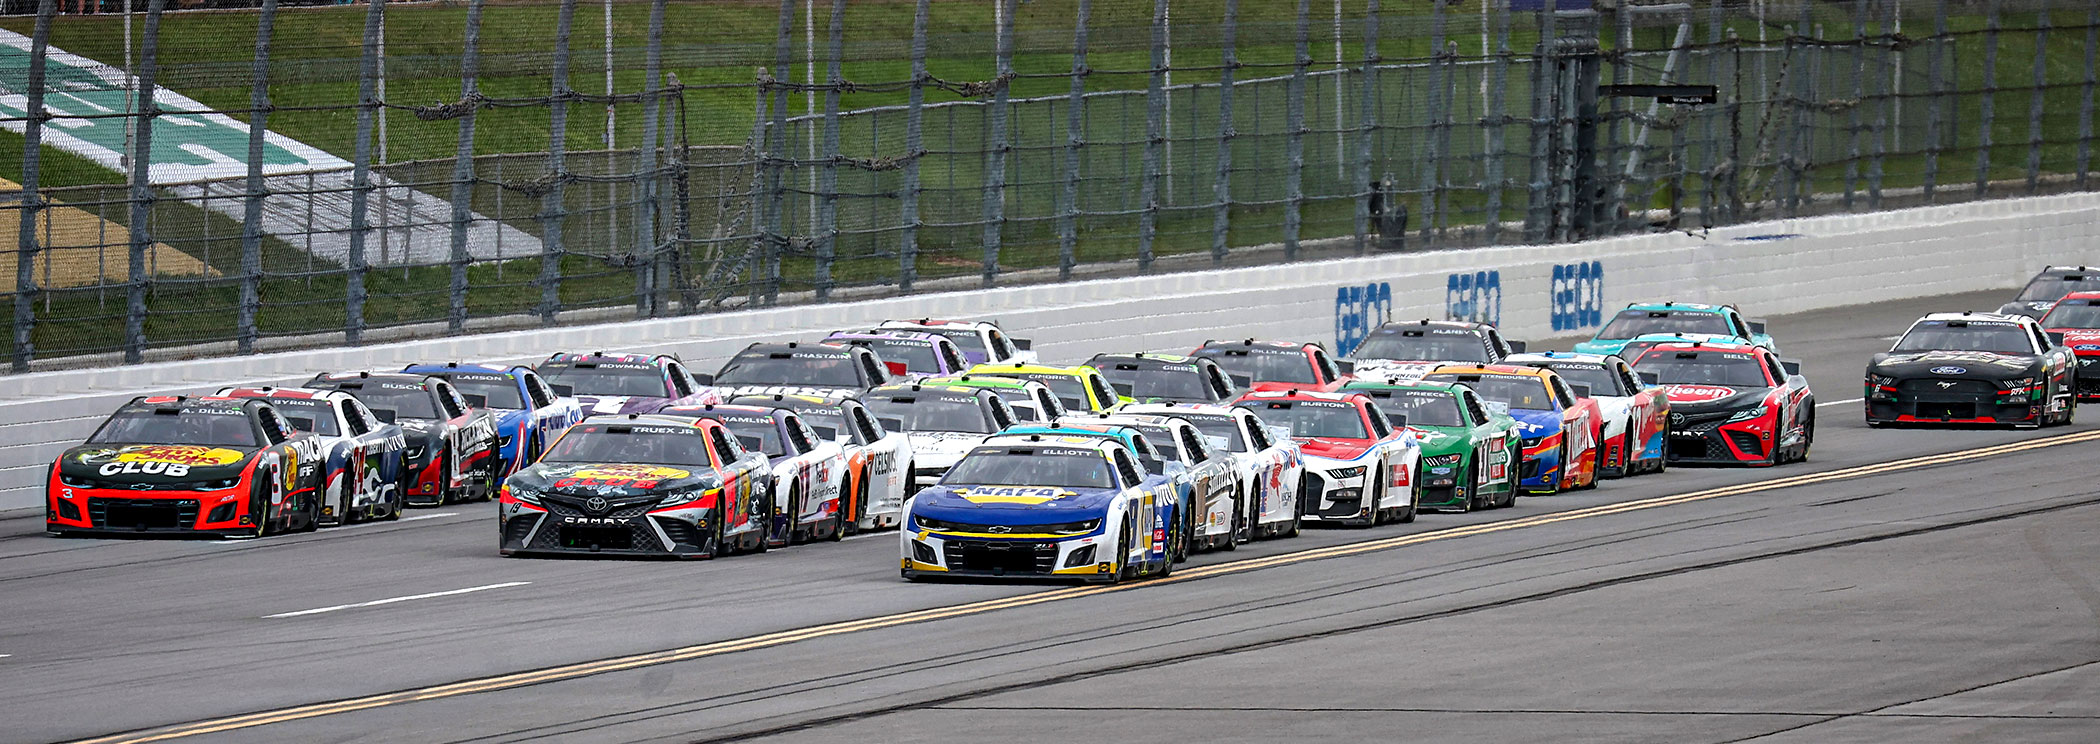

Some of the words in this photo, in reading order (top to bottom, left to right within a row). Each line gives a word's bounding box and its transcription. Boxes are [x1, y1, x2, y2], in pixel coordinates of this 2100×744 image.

[792, 352, 849, 360] CHASTAIN
[381, 383, 422, 391] BUSCH
[273, 399, 315, 407] BYRON
[198, 408, 245, 416] DILLON
[796, 406, 840, 416] LAJOIE
[723, 416, 769, 424] HAMLIN
[1042, 449, 1092, 457] ELLIOTT
[99, 461, 191, 477] CLUB
[554, 477, 659, 489] CLUB
[62, 488, 73, 499] 3
[972, 487, 1055, 497] NAPA
[510, 502, 523, 514] 19
[564, 517, 630, 525] CAMRY
